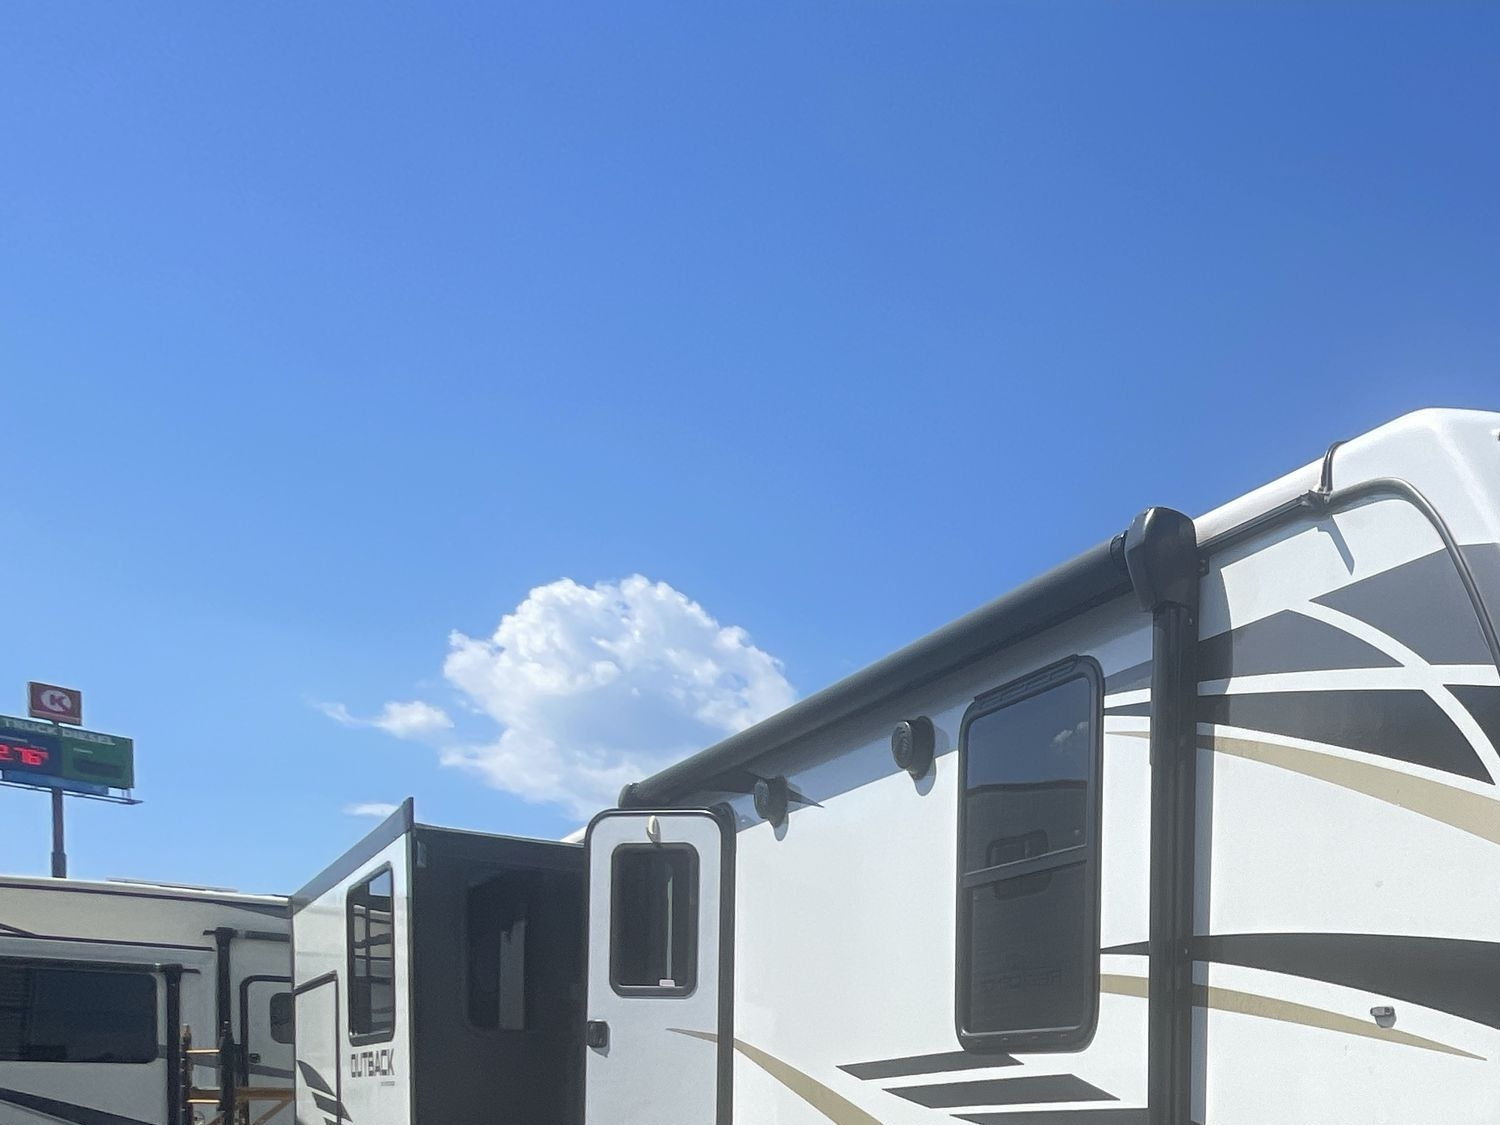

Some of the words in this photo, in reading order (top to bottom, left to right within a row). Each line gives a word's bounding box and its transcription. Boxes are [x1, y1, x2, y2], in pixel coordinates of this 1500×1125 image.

[4, 719, 57, 735] TRUCK
[62, 729, 116, 746] DIESEL
[351, 1048, 395, 1078] OUTBACK
